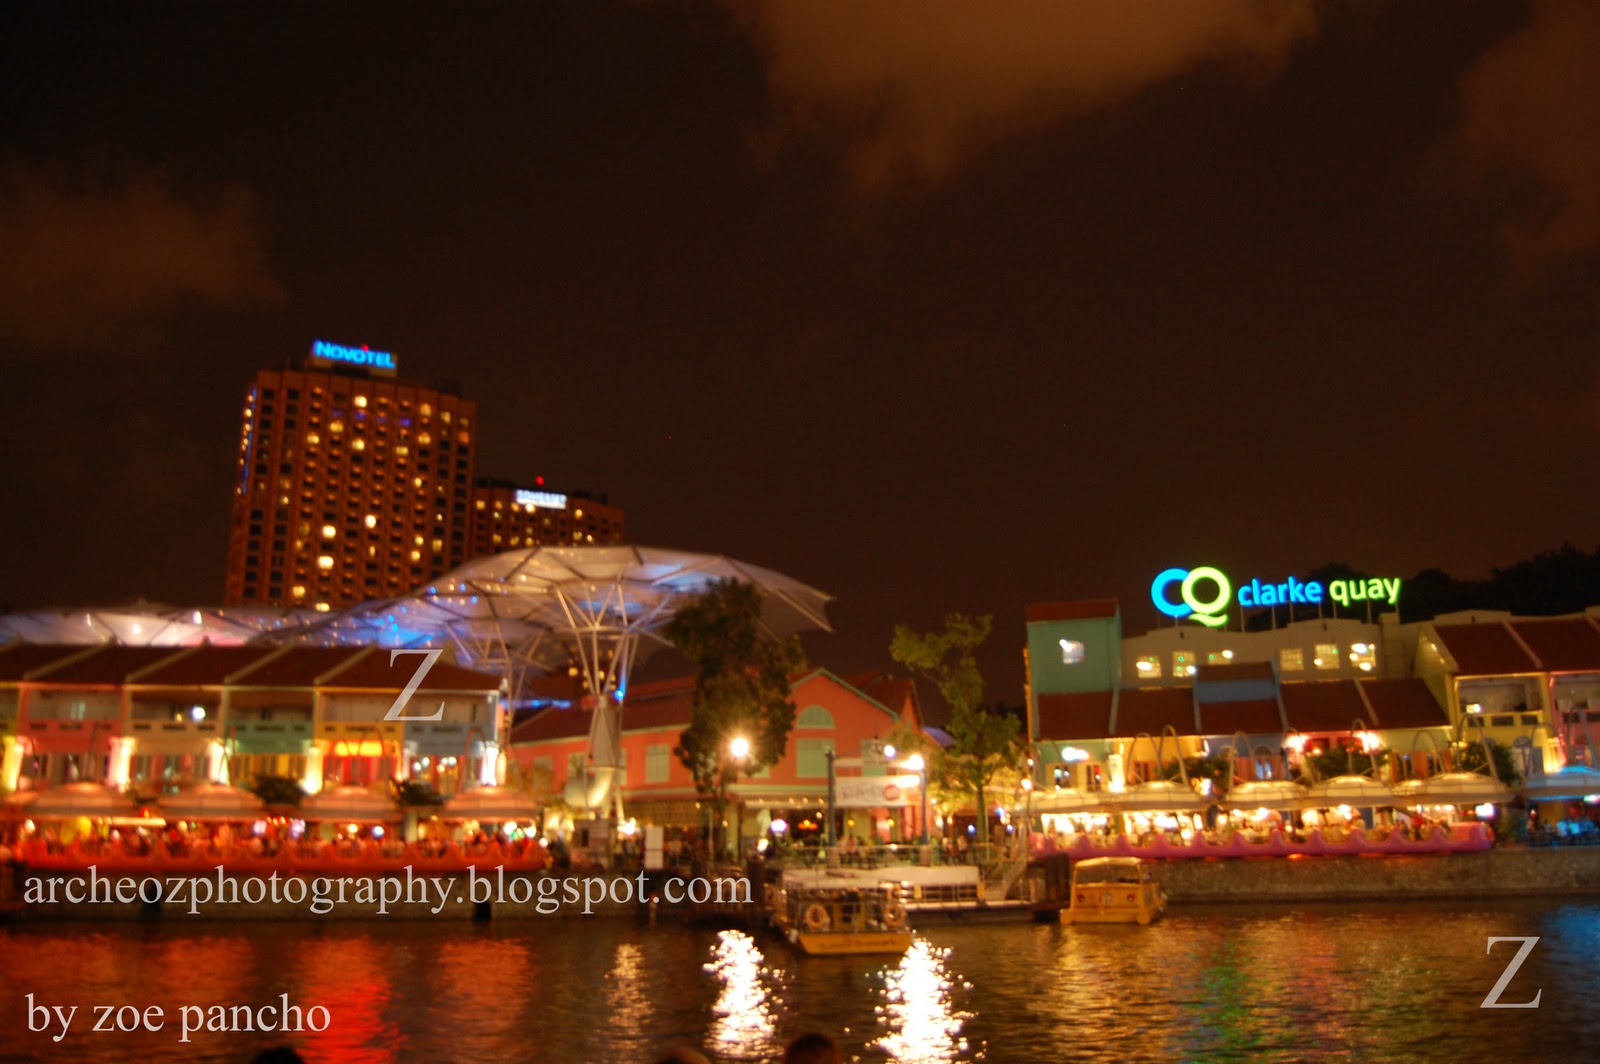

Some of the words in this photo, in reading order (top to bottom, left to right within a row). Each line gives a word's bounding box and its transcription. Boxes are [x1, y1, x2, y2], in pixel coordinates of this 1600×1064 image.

[313, 339, 396, 369] NOVOTEL
[1151, 566, 1231, 627] CQ
[1237, 576, 1323, 607] clarke
[1329, 577, 1400, 607] quay
